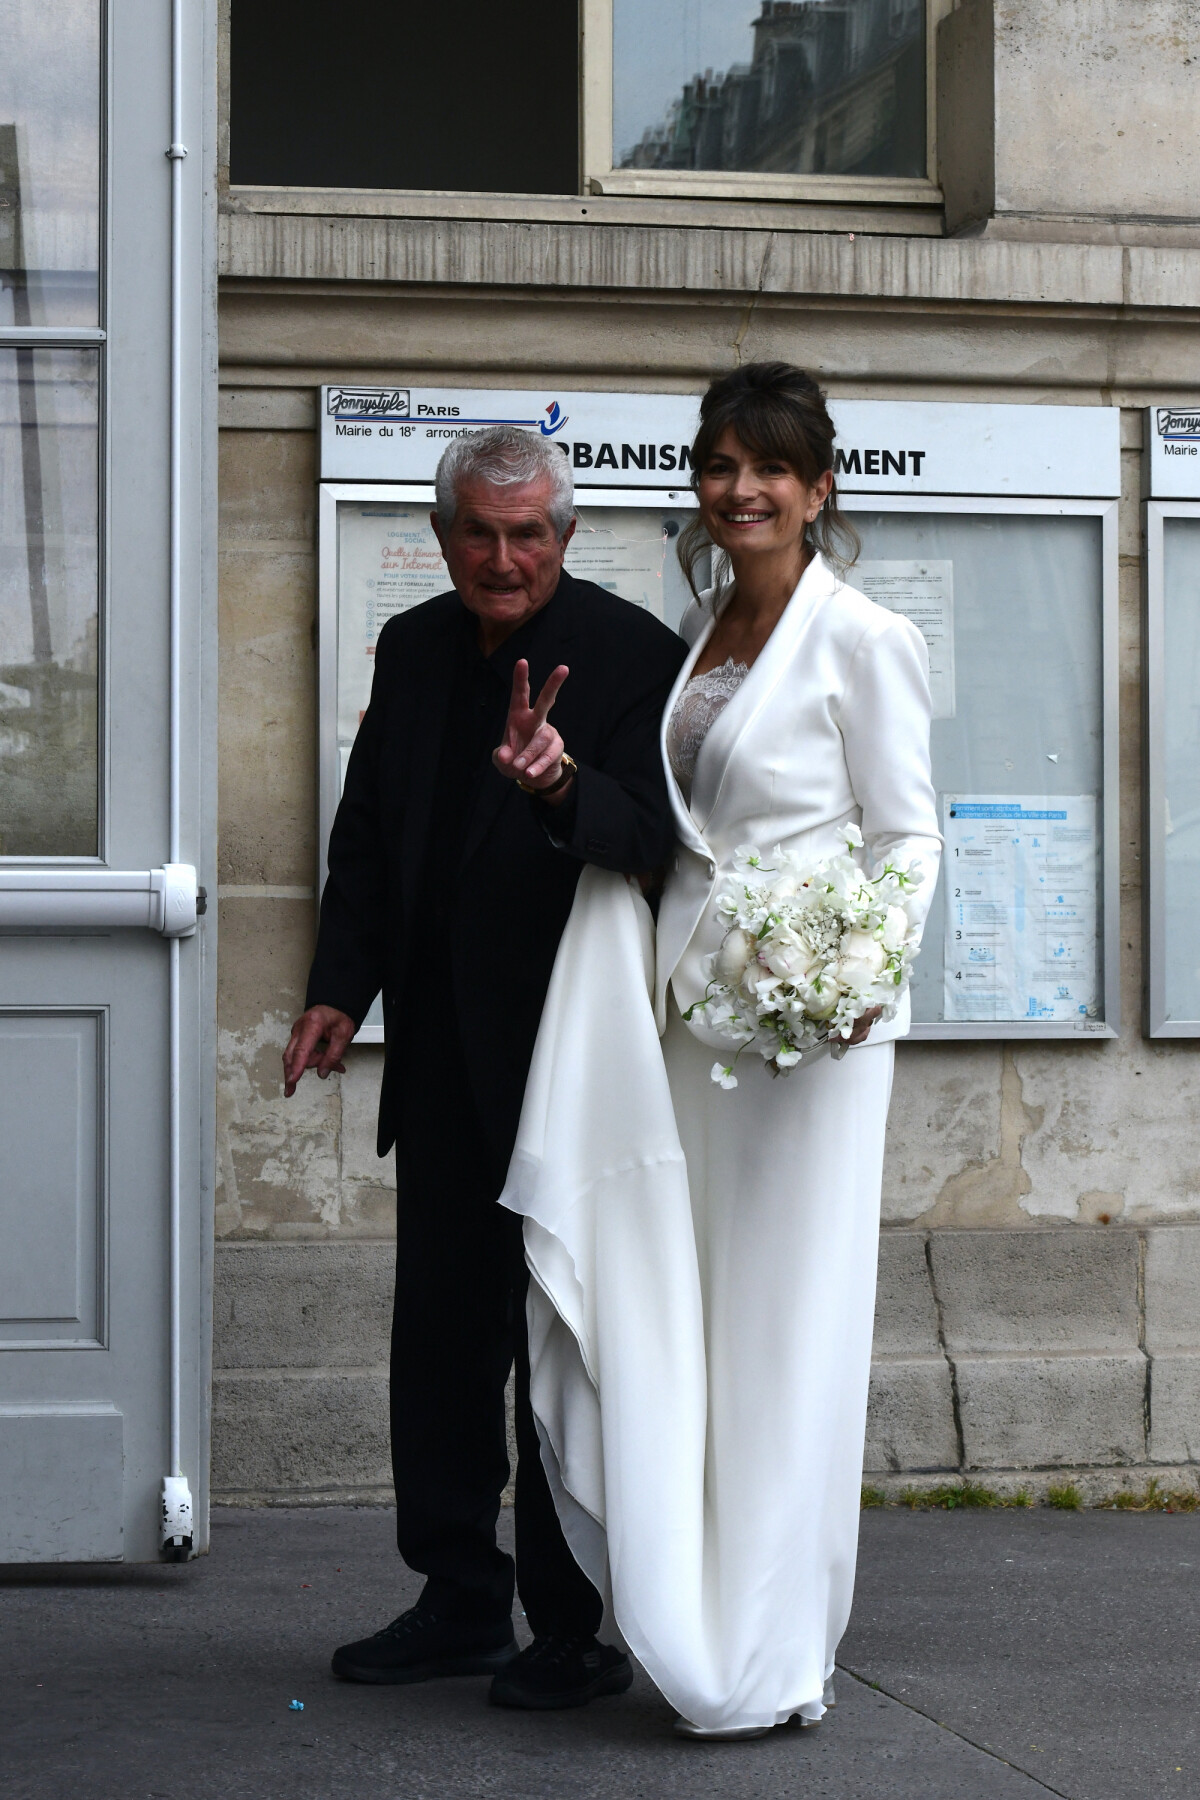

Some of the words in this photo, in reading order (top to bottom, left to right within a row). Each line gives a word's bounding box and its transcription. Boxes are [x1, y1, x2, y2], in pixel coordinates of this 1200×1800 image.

[417, 404, 460, 417] PARIS
[1160, 410, 1200, 433] Jonny
[335, 424, 372, 437] Mairie
[378, 425, 394, 438] du
[426, 427, 481, 439] arrondis
[1164, 444, 1198, 456] Mairie
[553, 442, 694, 471] BANISM
[833, 449, 925, 476] MENT
[413, 546, 443, 558] démarc
[380, 561, 399, 569] sur
[400, 557, 443, 570] Internet
[955, 848, 960, 857] 1
[955, 888, 961, 898] 2
[955, 930, 962, 940] 3
[955, 971, 962, 981] 4
